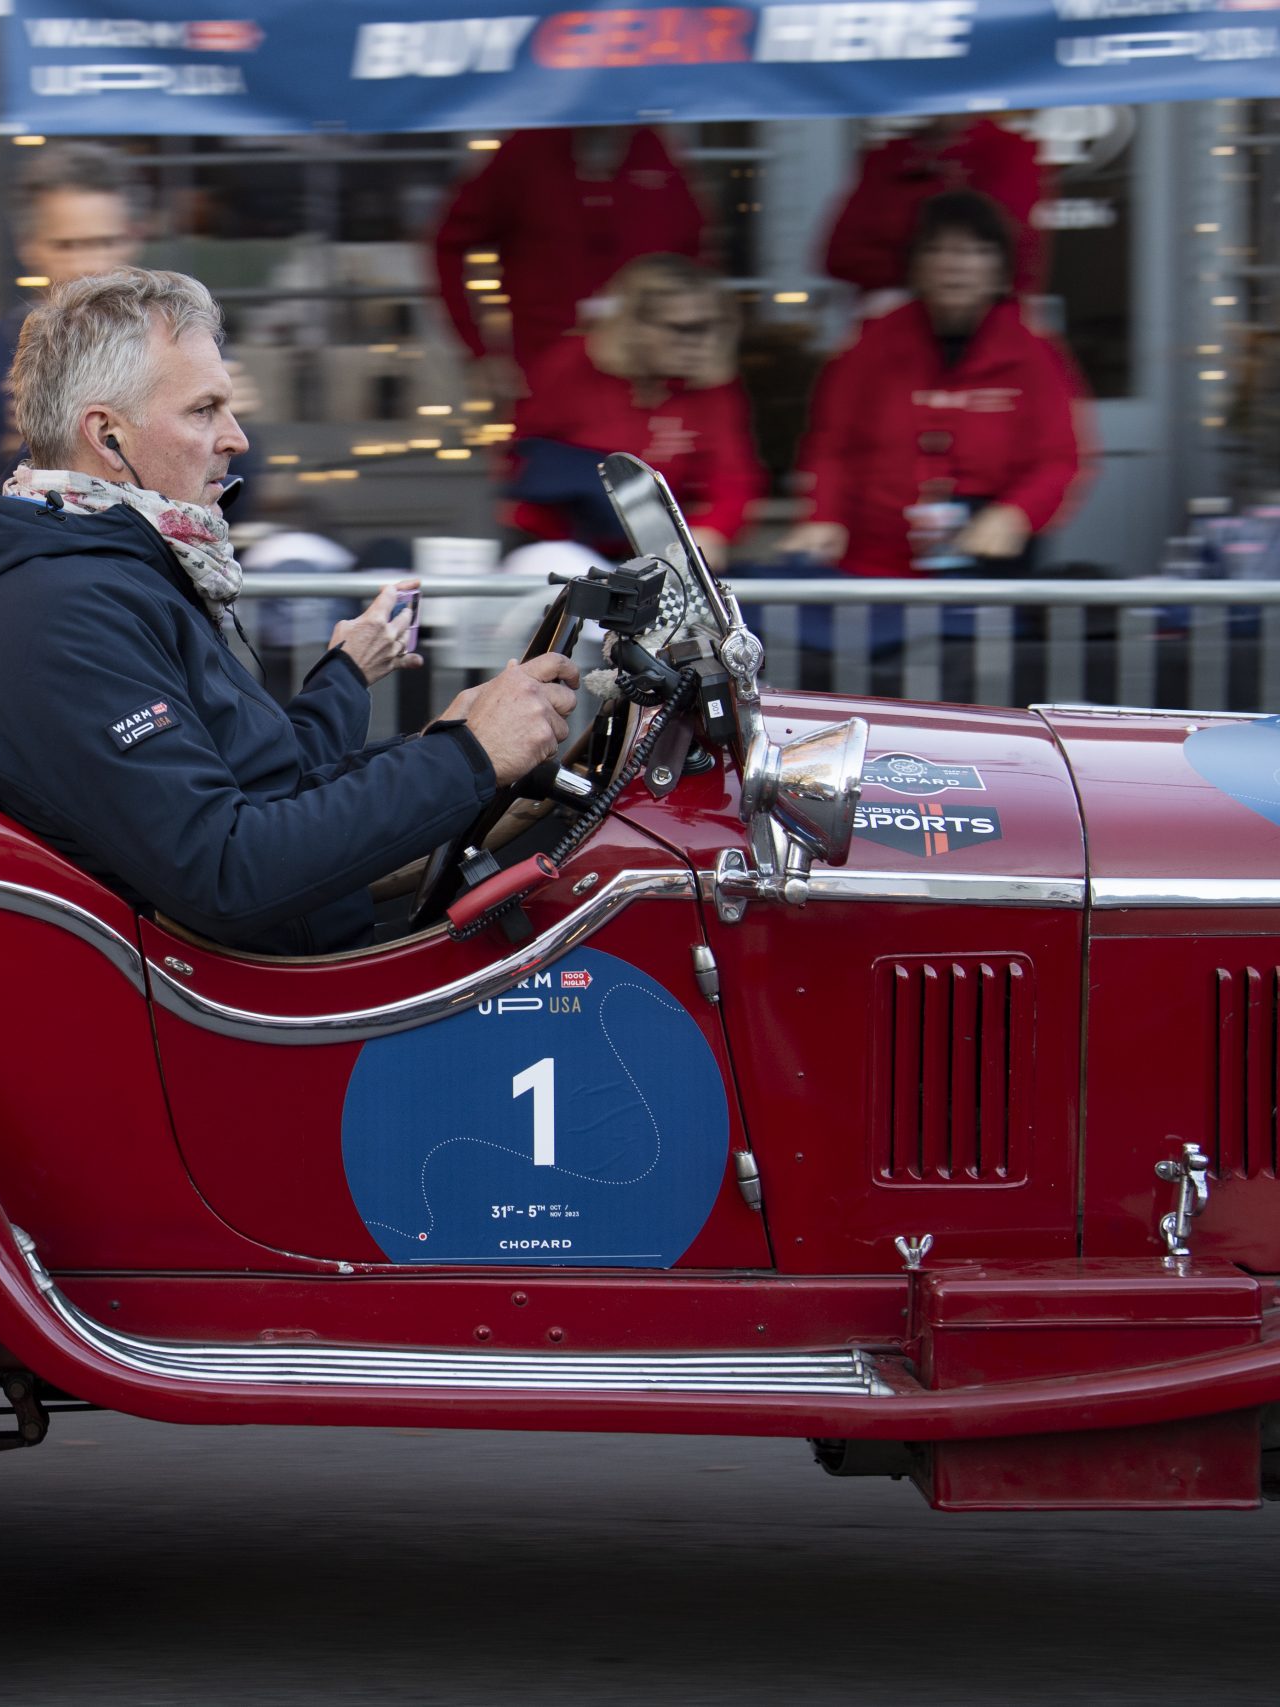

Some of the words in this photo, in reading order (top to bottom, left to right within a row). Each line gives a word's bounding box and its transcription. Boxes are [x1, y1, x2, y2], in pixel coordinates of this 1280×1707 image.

[351, 15, 536, 79] BUY
[532, 6, 756, 69] GEAR
[752, 0, 978, 63] HERE
[112, 708, 152, 734] WARM
[121, 721, 155, 744] UP
[155, 715, 172, 728] USA
[863, 775, 960, 787] CHOPARD
[855, 806, 917, 815] CUDERIA
[853, 813, 995, 834] SPORTS
[478, 997, 543, 1015] UP
[549, 996, 581, 1014] USA
[512, 1057, 555, 1166] 1
[491, 1205, 515, 1218] 31ST
[528, 1204, 546, 1218] 5TH
[499, 1239, 572, 1249] CHOPARD
